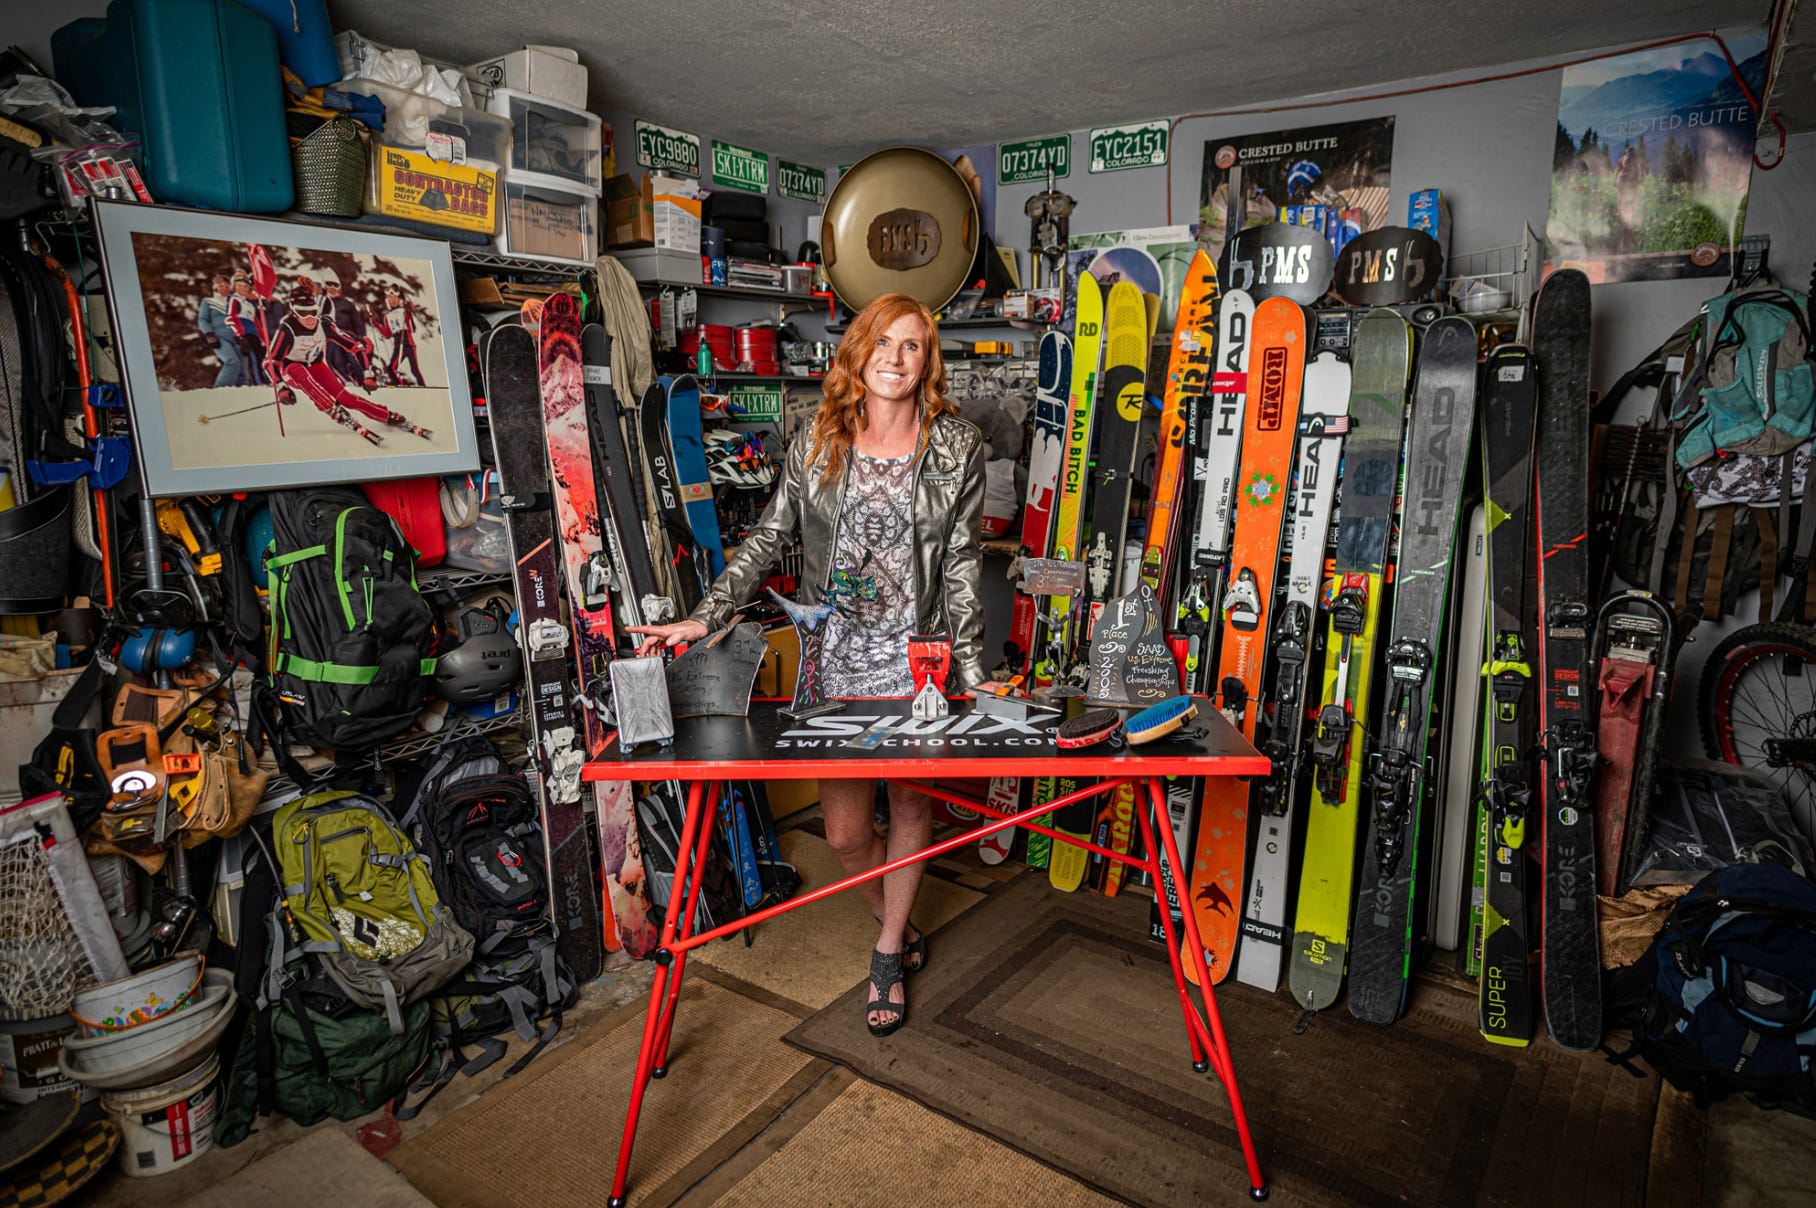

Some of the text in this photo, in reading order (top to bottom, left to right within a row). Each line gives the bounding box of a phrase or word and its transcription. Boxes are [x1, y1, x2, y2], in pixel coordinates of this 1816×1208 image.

[1604, 106, 1749, 137] CRESTED BUTTE
[639, 132, 697, 165] EYC9880
[1094, 132, 1163, 160] EYC2151
[1239, 137, 1338, 159] CRESTED BUTTE
[653, 157, 688, 172] COLORADO
[1002, 146, 1066, 173] 07374YD
[1106, 155, 1149, 168] COLORADO
[779, 168, 824, 195] 07374YD
[1013, 168, 1048, 180] COLORAD
[394, 169, 489, 202] CONTRACTOR
[394, 186, 421, 196] HEAVY
[394, 193, 417, 202] DUTY
[451, 195, 488, 217] BAGS
[1259, 245, 1312, 284] PMS
[1349, 248, 1398, 284] PMS
[1756, 349, 1767, 398] SALOMON
[1262, 351, 1284, 427] ROMP
[1065, 409, 1086, 494] BAD BITCH
[1417, 387, 1455, 536] HEAD
[1111, 598, 1138, 630] 1st
[805, 633, 824, 654] 2nd
[1101, 629, 1128, 639] Place
[1141, 654, 1174, 666] Extreme
[687, 670, 720, 681] Extreme
[1555, 672, 1580, 680] DESIGN
[541, 685, 562, 694] DESIGN
[781, 715, 1062, 736] SWIX
[1061, 778, 1077, 789] ROS
[988, 797, 1017, 816] SKIS
[1245, 923, 1281, 939] HEAD
[1489, 966, 1506, 1029] SUPER
